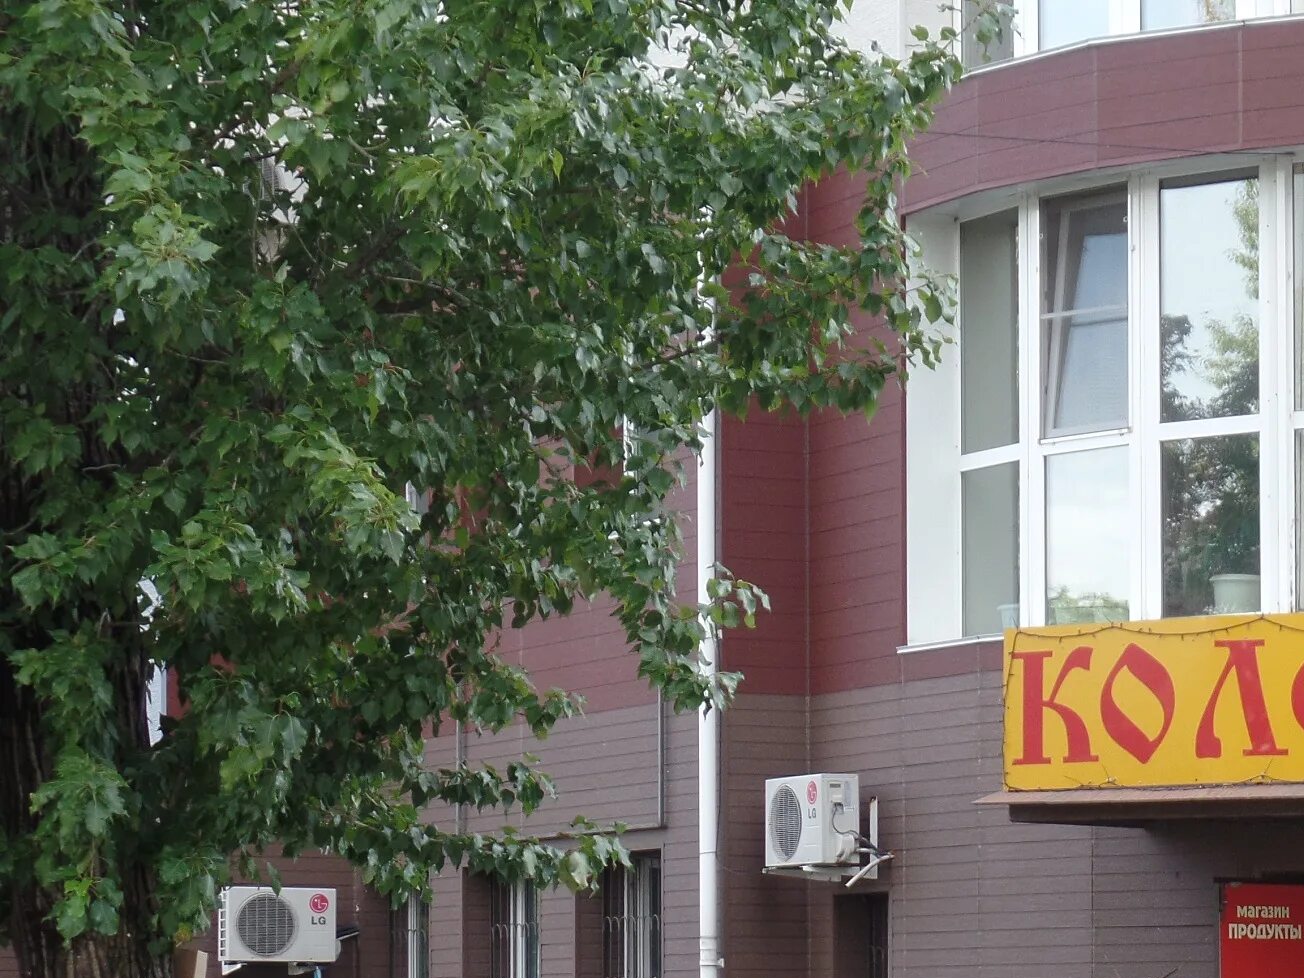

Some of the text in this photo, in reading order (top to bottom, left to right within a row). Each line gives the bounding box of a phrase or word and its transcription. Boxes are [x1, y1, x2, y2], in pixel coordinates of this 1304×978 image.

[807, 807, 817, 819] LG
[1236, 905, 1290, 919] магазин
[311, 915, 327, 926] LG
[1228, 922, 1303, 940] ПРОДУКТЫ
